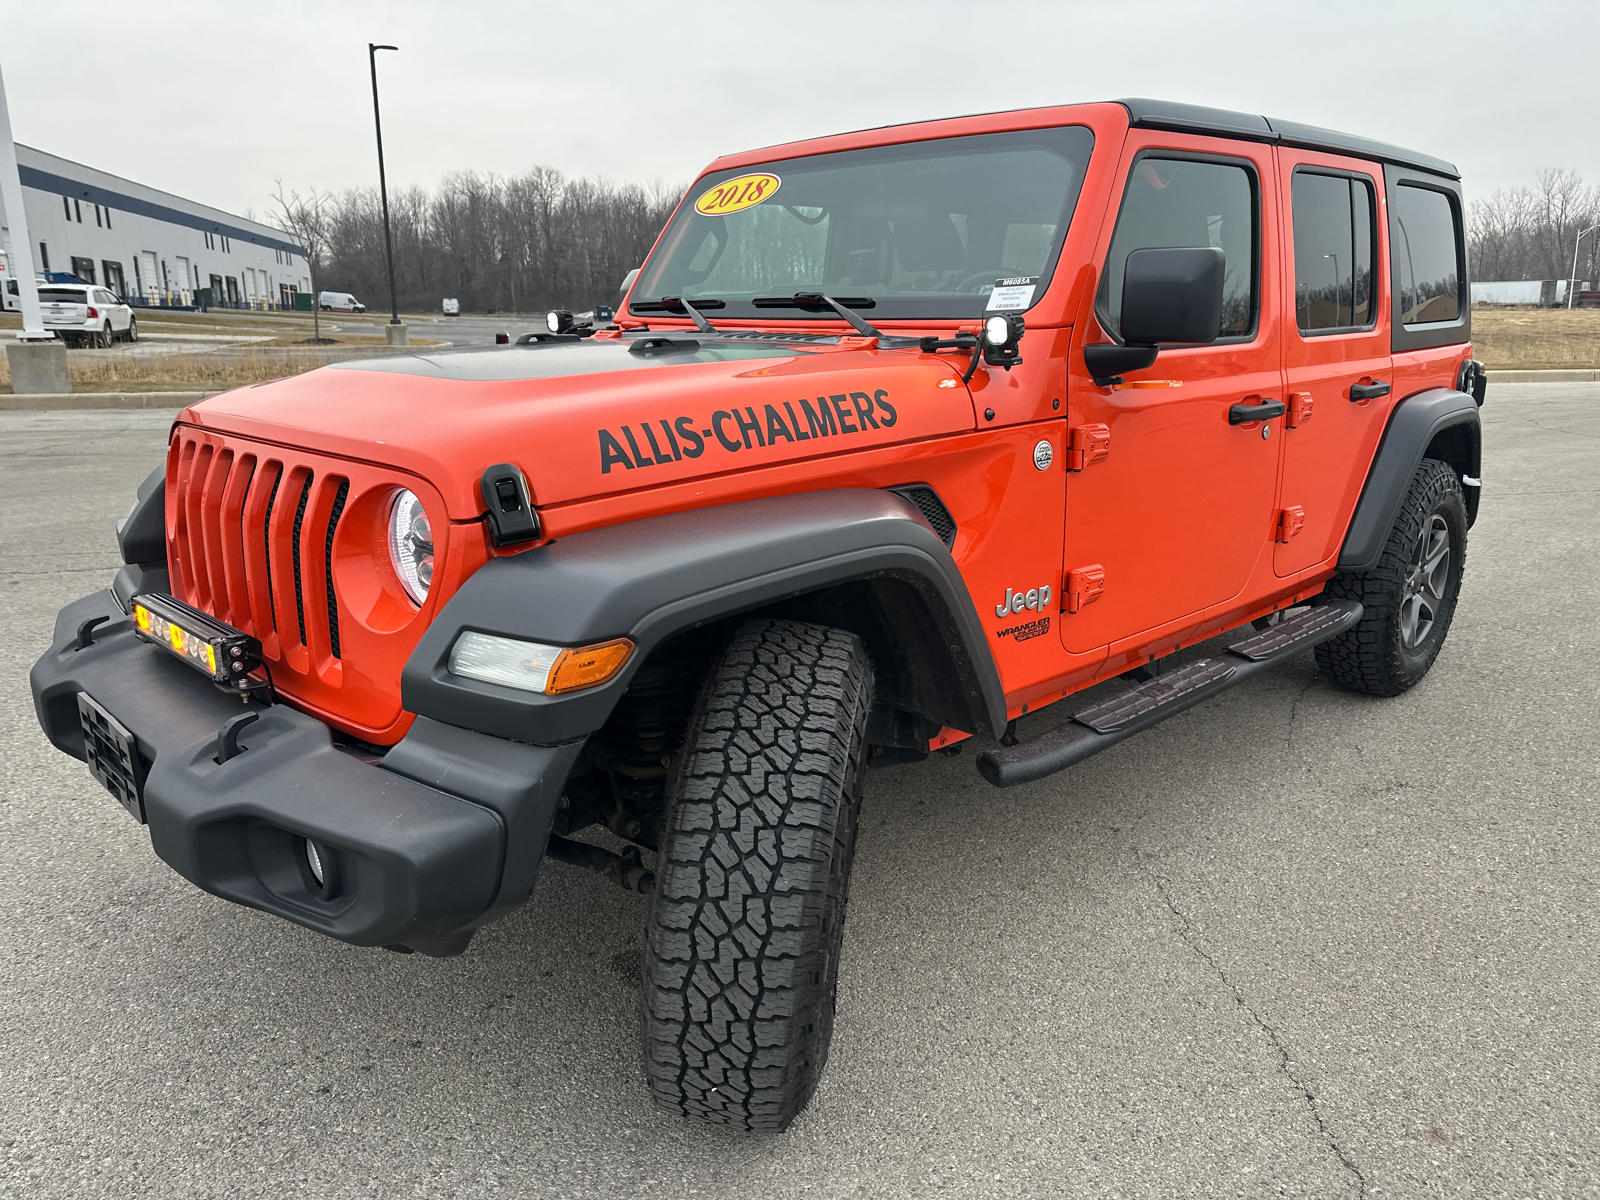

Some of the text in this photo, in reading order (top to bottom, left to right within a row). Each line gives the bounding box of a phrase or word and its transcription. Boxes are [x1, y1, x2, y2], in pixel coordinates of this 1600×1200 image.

[703, 178, 770, 211] 2018
[598, 389, 898, 475] ALLIS-CHALMERS
[996, 585, 1052, 618] Jeep
[997, 617, 1050, 638] WRANGLER
